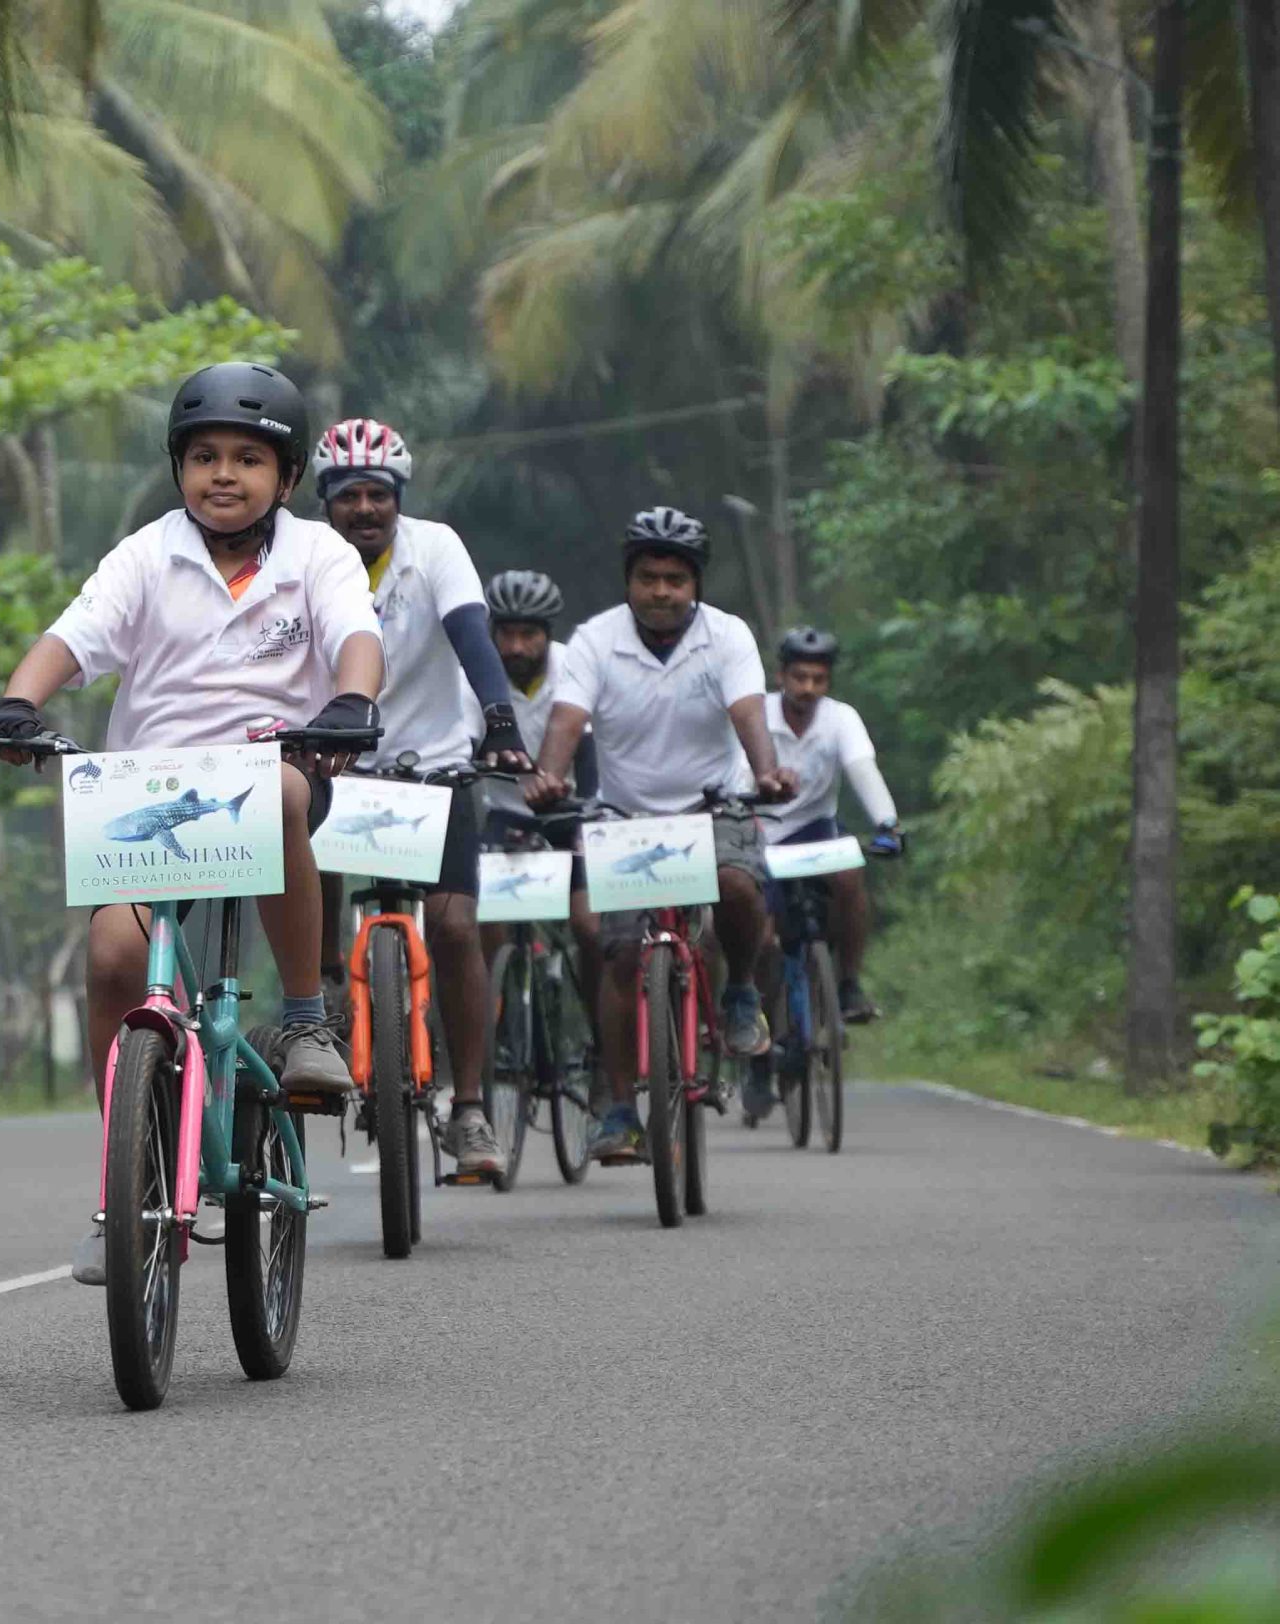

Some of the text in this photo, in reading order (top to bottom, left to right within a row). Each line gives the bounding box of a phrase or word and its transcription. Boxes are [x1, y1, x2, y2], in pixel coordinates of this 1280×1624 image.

[275, 616, 301, 635] 25
[95, 849, 176, 869] WHALE
[81, 867, 263, 888] CONSERVATION PROJECT
